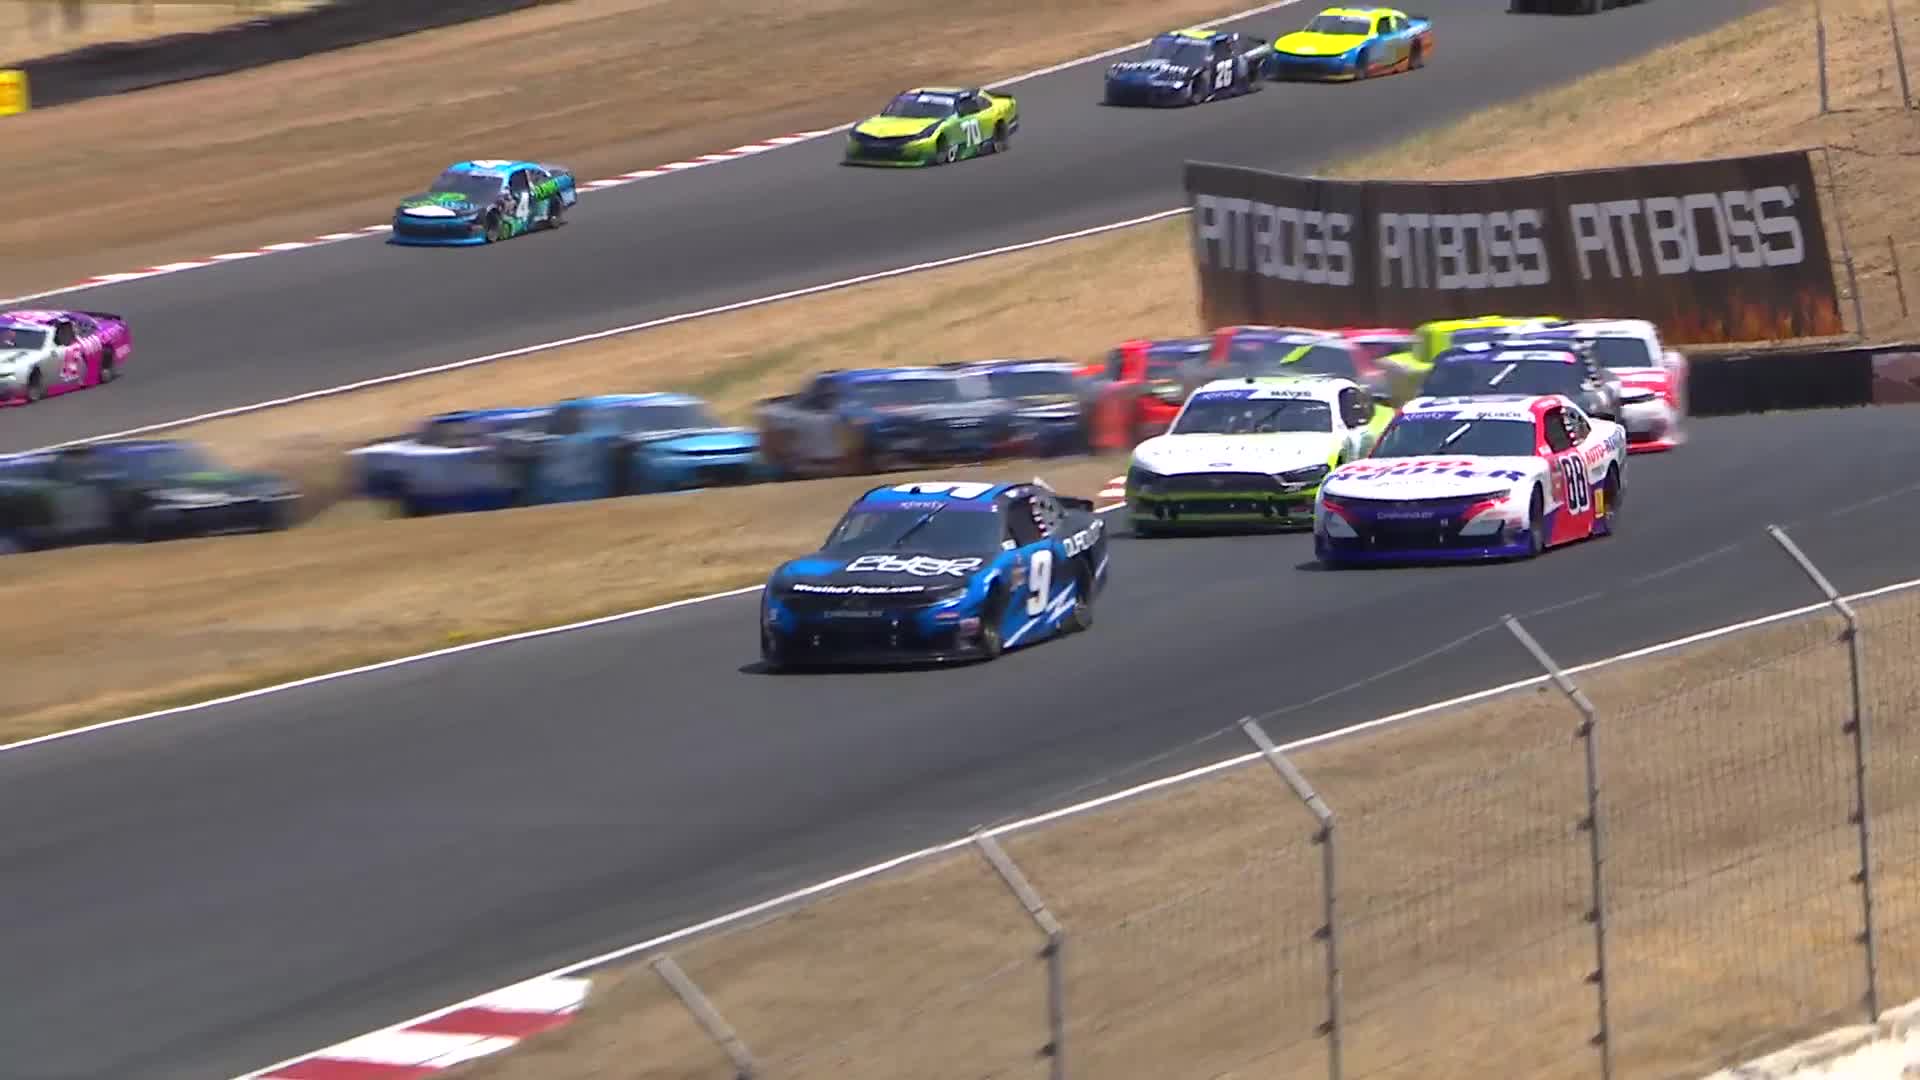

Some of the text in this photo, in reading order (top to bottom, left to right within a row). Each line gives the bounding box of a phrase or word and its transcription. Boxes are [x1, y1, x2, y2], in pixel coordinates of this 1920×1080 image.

[1197, 194, 1353, 286] PIT BOSS
[1380, 209, 1550, 289] PIT BOSS
[1569, 186, 1804, 279] PIT BOSS
[1559, 453, 1590, 513] 88
[1027, 550, 1052, 616] 9
